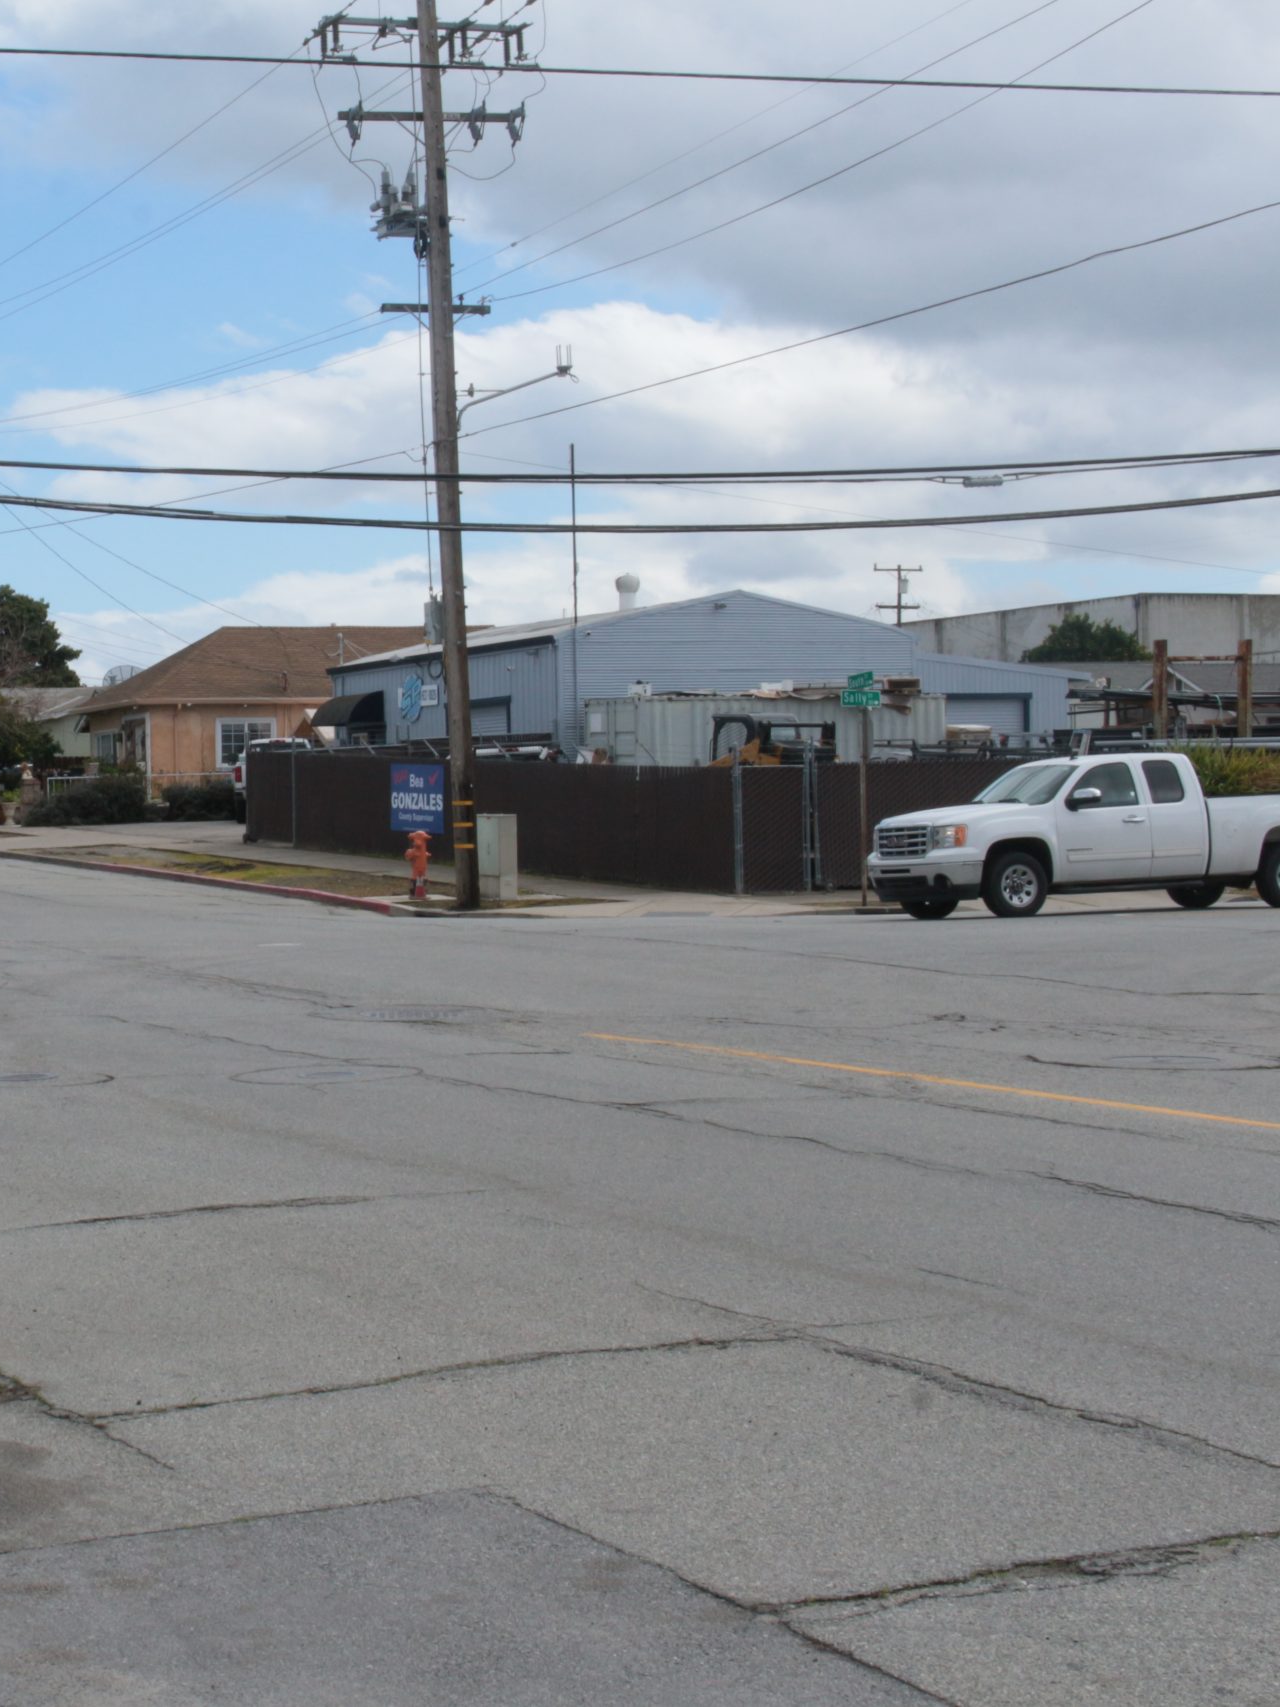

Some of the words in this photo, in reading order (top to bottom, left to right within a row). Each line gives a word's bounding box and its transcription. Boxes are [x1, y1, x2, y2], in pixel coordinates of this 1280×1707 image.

[843, 692, 867, 705] Sally
[409, 773, 424, 788] Bea
[391, 792, 443, 811] GONZALES
